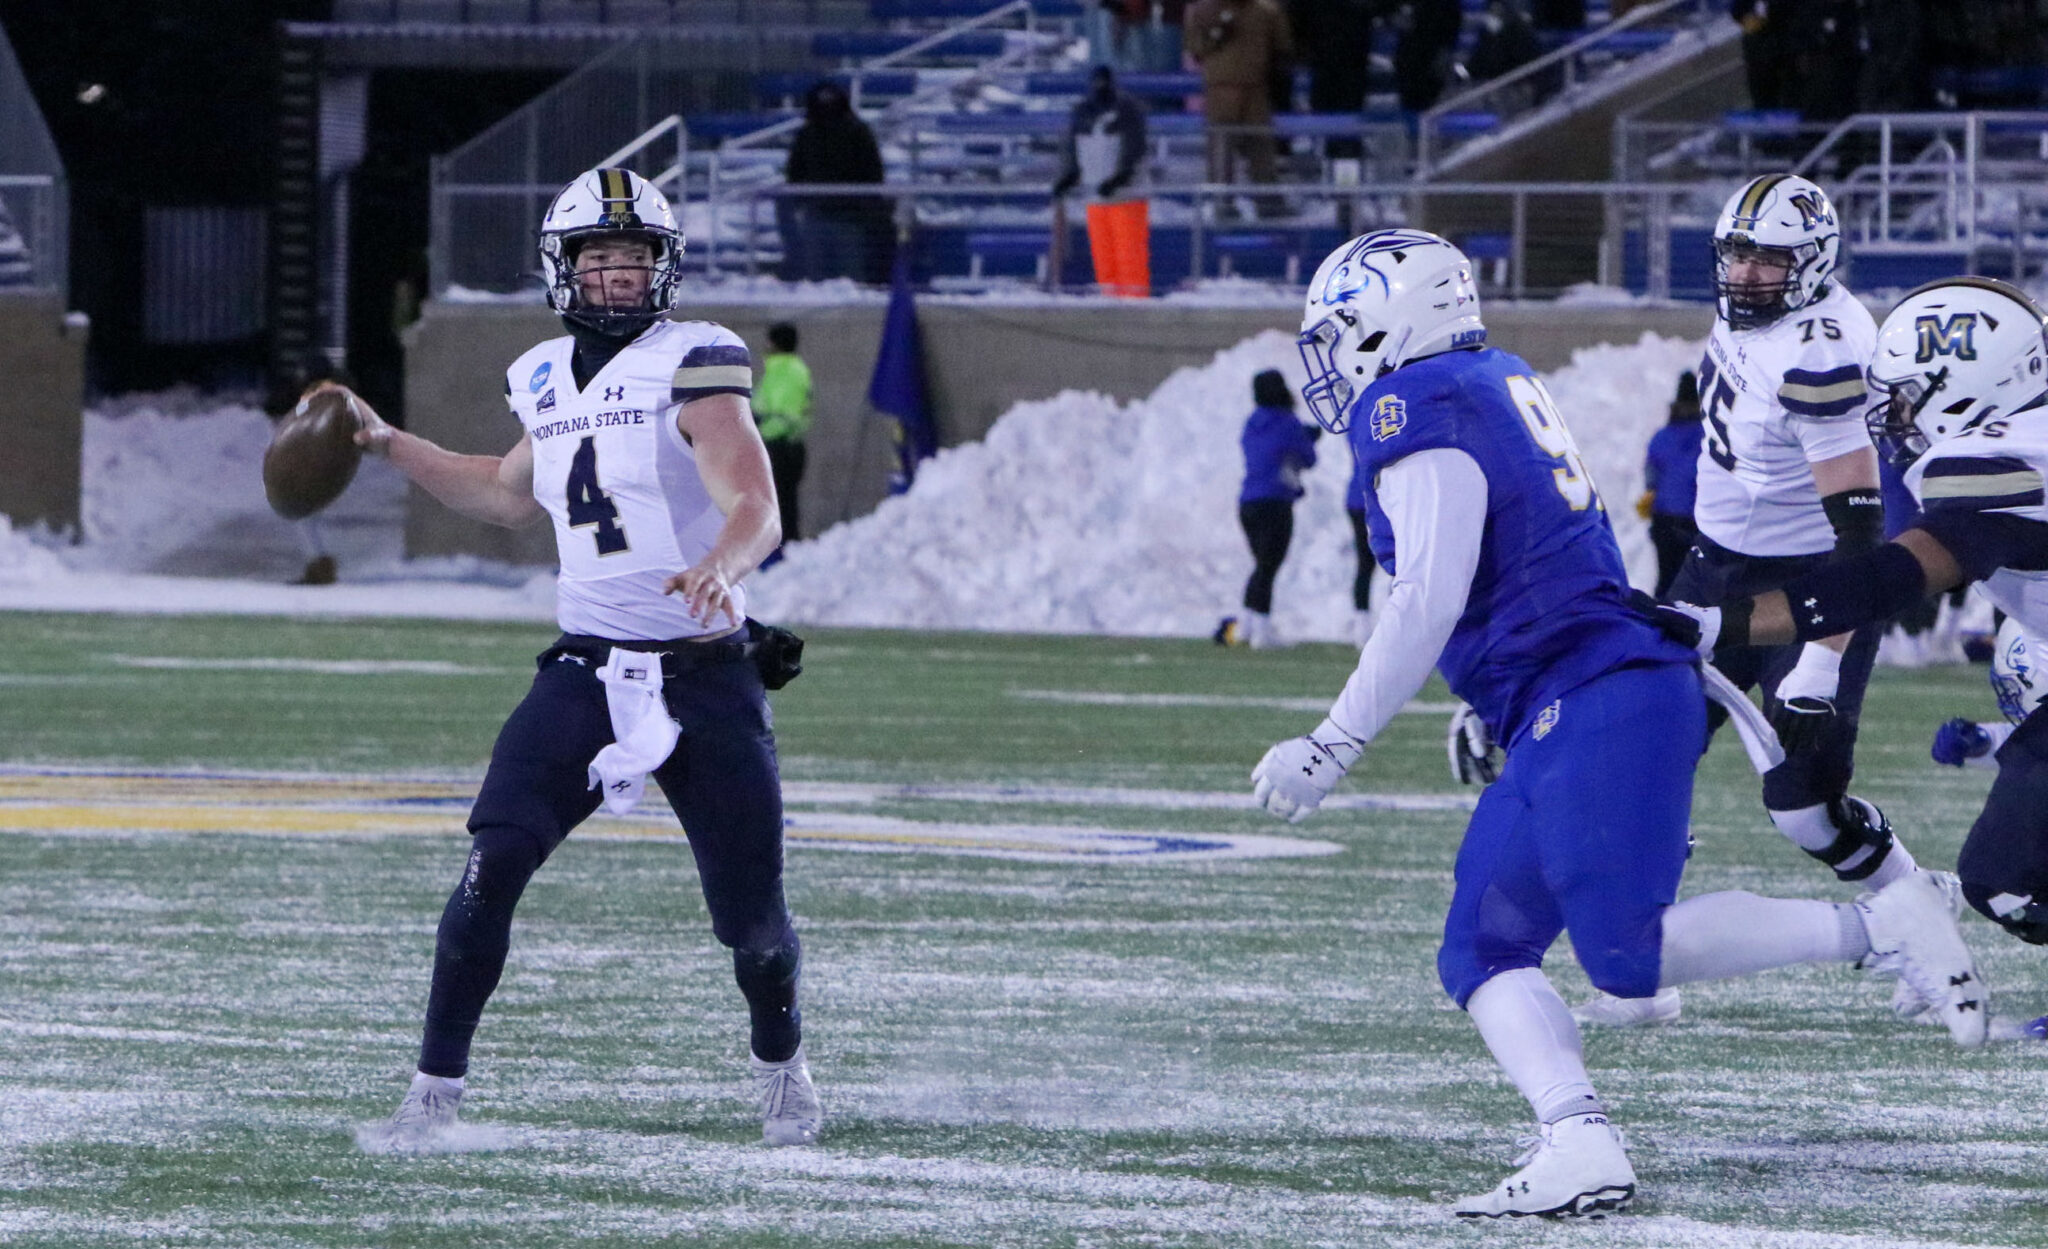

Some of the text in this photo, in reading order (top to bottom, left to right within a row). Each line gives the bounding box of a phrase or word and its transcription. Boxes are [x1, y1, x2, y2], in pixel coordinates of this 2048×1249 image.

[608, 212, 631, 223] 406
[1788, 190, 1834, 232] M
[1796, 317, 1843, 343] 75
[1914, 313, 1978, 364] M
[532, 410, 645, 441] MONTANA STATE
[565, 434, 632, 558] 4
